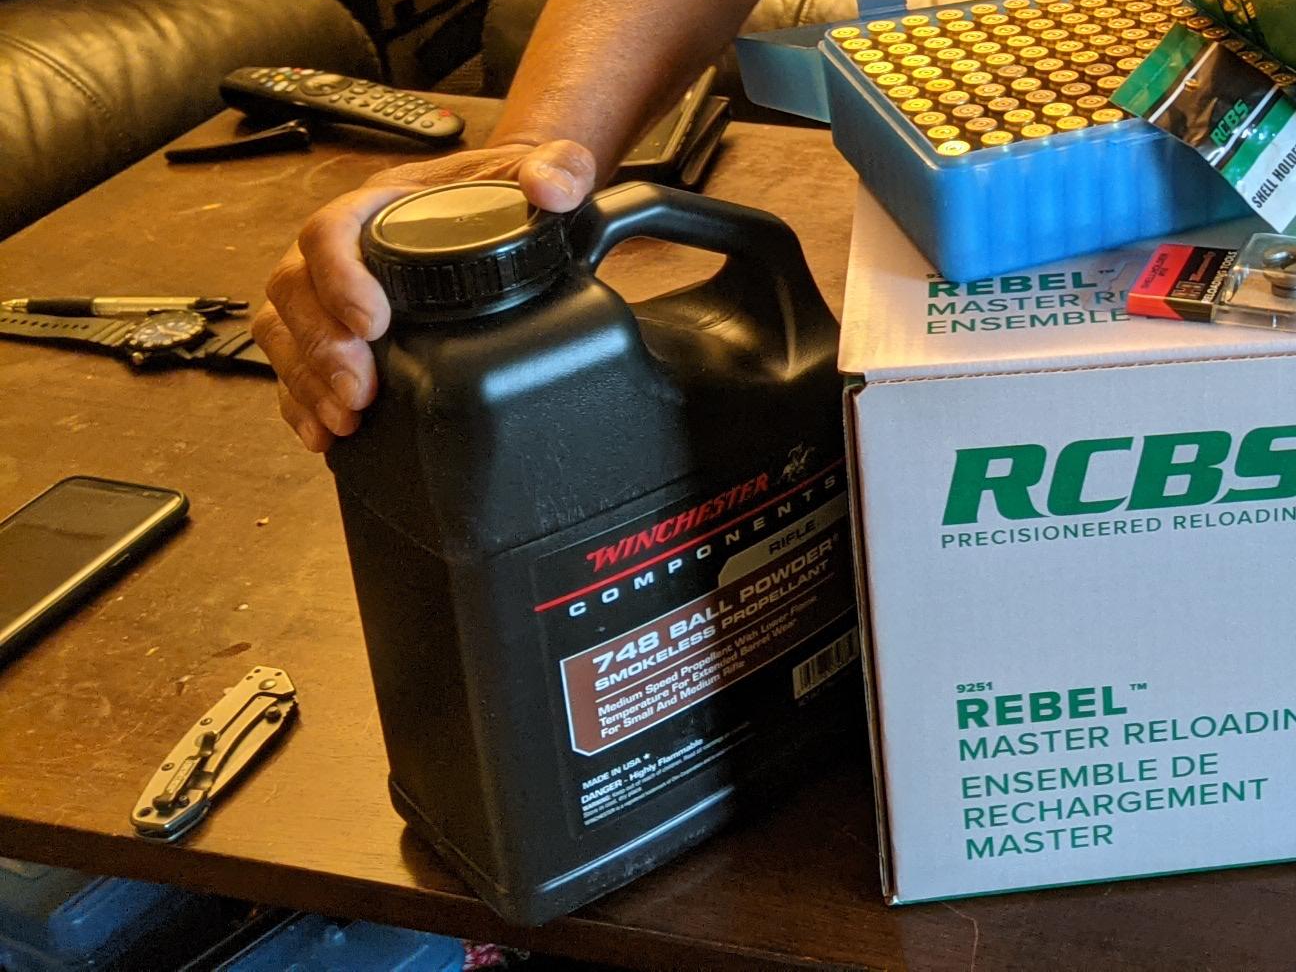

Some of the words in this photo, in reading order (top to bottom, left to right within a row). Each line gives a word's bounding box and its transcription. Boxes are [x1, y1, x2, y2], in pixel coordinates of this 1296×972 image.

[1209, 98, 1250, 148] RCBS
[1251, 178, 1279, 209] SHELL
[927, 293, 1080, 317] MASTER
[928, 271, 1098, 299] REBEL
[926, 307, 1132, 335] ENSEMBLE
[584, 471, 770, 574] WINCHESTER
[767, 518, 818, 556] RIFLE
[941, 516, 1163, 549] PRECISIONEERED
[568, 476, 836, 618] COMPONENTS
[592, 631, 660, 674] 748
[668, 601, 734, 641] BALL
[738, 539, 835, 604] POWDER
[593, 625, 717, 693] SMOKELESS
[720, 558, 831, 630] PROPELLANT
[597, 690, 643, 717] Medium
[645, 671, 678, 695] Speed
[680, 644, 734, 678] Propellant
[598, 688, 669, 728] Temperature
[672, 678, 689, 695] For
[692, 650, 737, 683] Extended
[956, 681, 993, 695] 9251
[600, 726, 621, 739] For
[623, 708, 654, 728] Small
[656, 696, 678, 713] And
[679, 672, 721, 700] Medium
[956, 686, 1129, 730] REBEL
[959, 727, 1110, 762] MASTER
[581, 778, 623, 805] DANGER
[629, 763, 657, 780] Highly
[657, 738, 704, 767] Flammable
[582, 774, 610, 790] MADE
[610, 767, 622, 777] IN
[623, 757, 642, 771] USA
[961, 759, 1158, 800] ENSEMBLE
[1172, 753, 1219, 780] DE
[964, 778, 1269, 830] RECHARGEMENT
[966, 824, 1114, 861] MASTER
